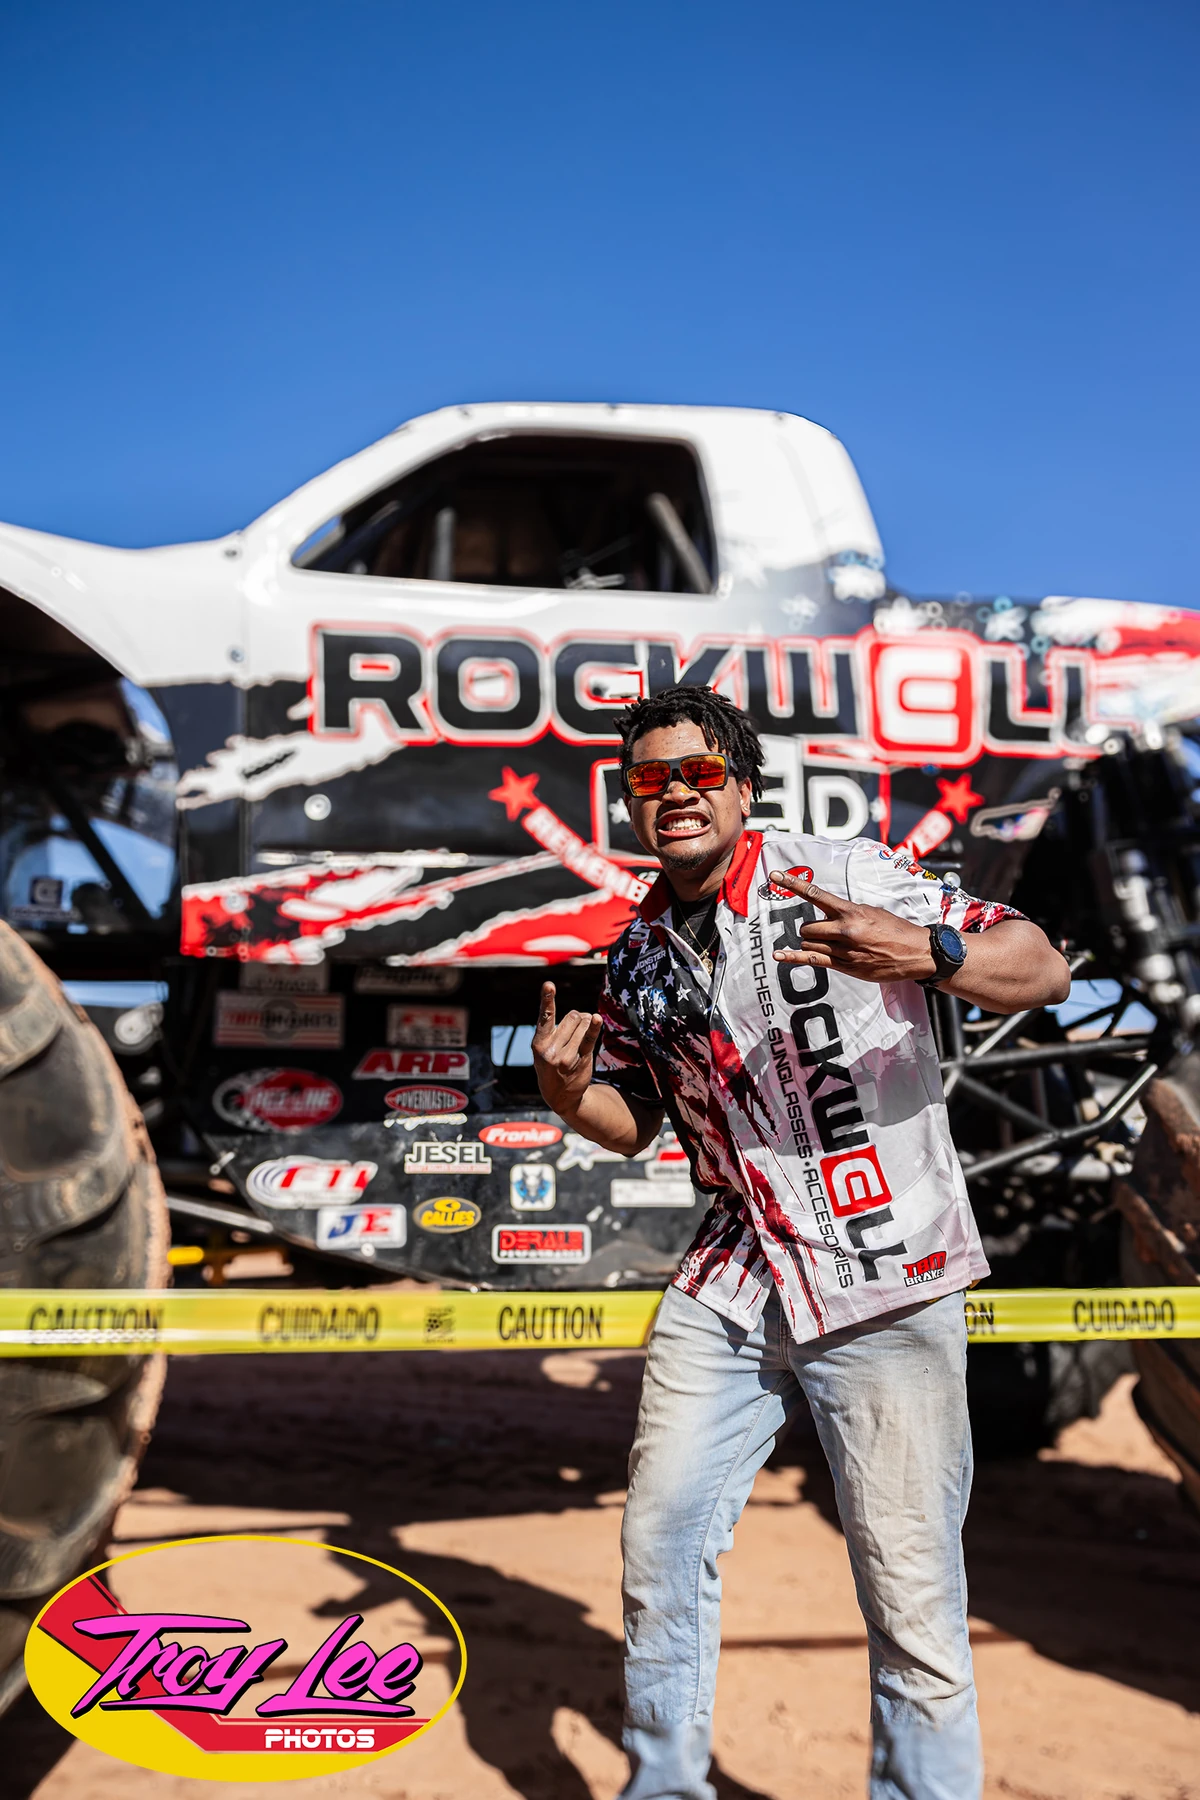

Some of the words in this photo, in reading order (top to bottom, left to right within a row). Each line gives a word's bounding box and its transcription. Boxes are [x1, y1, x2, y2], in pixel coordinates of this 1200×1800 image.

[314, 627, 1118, 760] ROCKWELL
[635, 950, 667, 970] MONSTER
[643, 962, 658, 975] JAM
[360, 1050, 468, 1074] ARP
[749, 916, 775, 1018] WATCHES
[767, 1027, 812, 1158] SUNGLASSES
[803, 1169, 854, 1289] ACCESORIES
[768, 902, 908, 1282] ROCKWELL
[486, 1127, 557, 1143] Fronius
[408, 1144, 489, 1164] JESEL
[501, 1231, 583, 1250] DERALE
[902, 1250, 946, 1279] TBM
[905, 1268, 944, 1287] BRAKES
[260, 1305, 380, 1342] CUIDADO
[498, 1305, 604, 1341] CAUTION
[1072, 1300, 1176, 1332] CUIDADO
